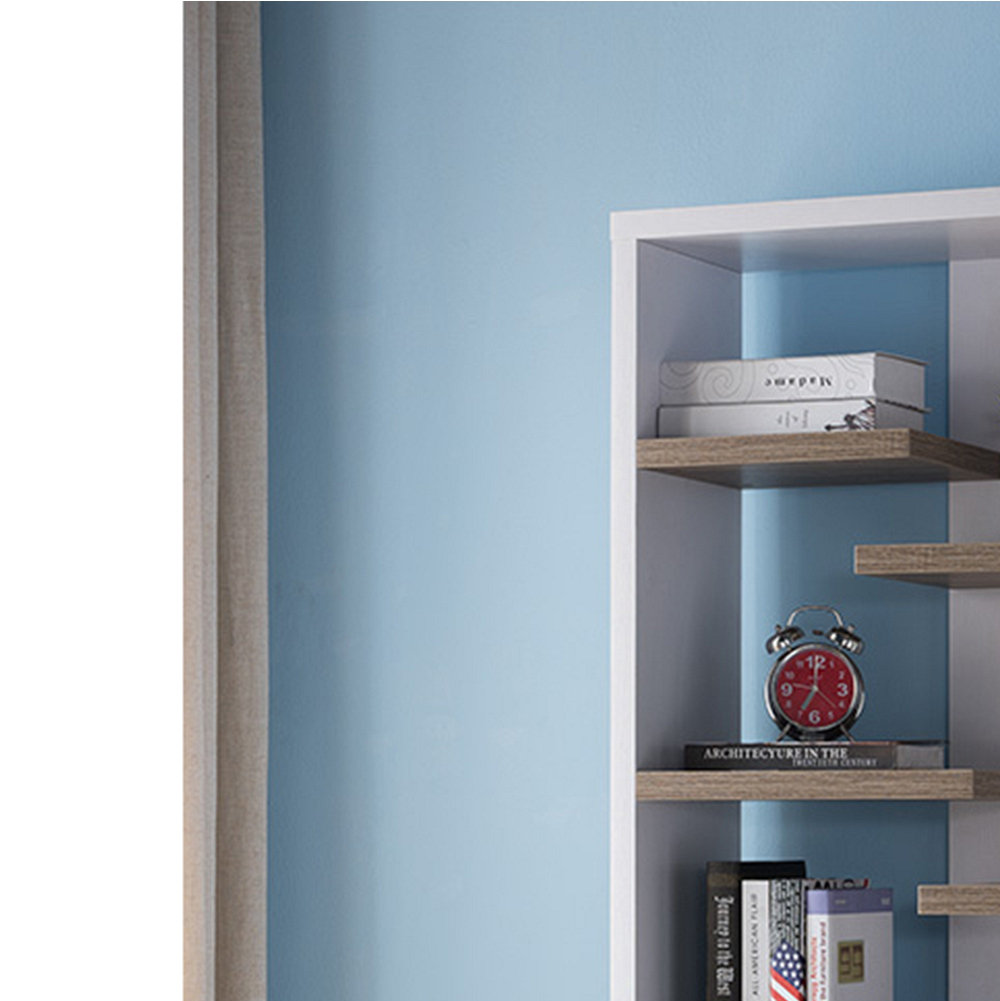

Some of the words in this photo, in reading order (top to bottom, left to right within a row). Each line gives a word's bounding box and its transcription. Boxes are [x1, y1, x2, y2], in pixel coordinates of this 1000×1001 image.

[764, 376, 832, 388] Madame
[806, 655, 826, 669] 12
[781, 682, 793, 697] 9
[837, 682, 848, 697] 3
[809, 709, 821, 724] 6
[804, 748, 818, 759] IN
[820, 748, 849, 759] THE
